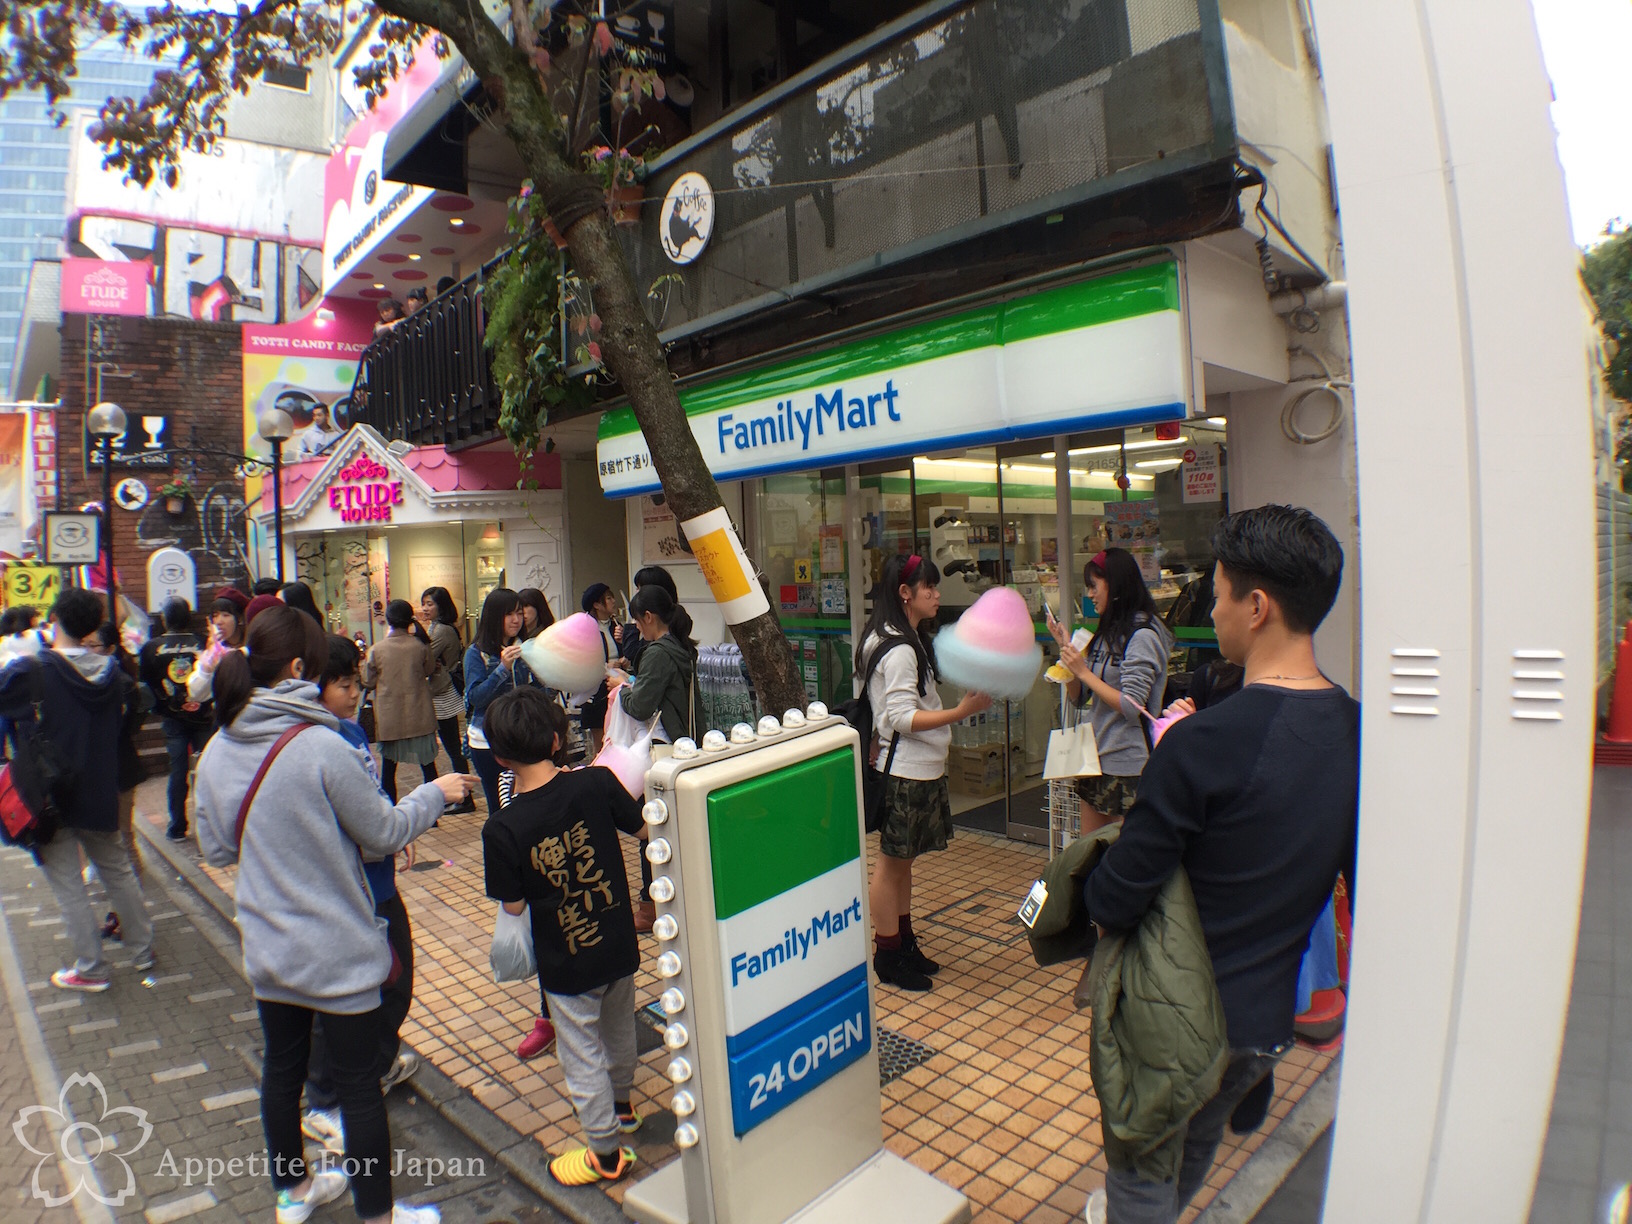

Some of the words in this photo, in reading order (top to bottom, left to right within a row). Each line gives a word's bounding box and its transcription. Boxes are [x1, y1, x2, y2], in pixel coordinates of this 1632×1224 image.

[683, 186, 707, 212] Coffee
[81, 284, 128, 300] ETUDE
[87, 300, 121, 308] HOUSE
[250, 335, 289, 347] TOTTI
[291, 339, 335, 351] CANDY
[717, 379, 901, 454] FamilyMart
[599, 452, 654, 477] 原宿竹下通り
[328, 482, 404, 509] ETUDE
[340, 506, 392, 522] HOUSE
[15, 573, 31, 594] 3
[530, 836, 603, 955] 俺の人生だ
[731, 896, 862, 987] FamilyMart
[748, 1060, 785, 1111] 24
[787, 1012, 863, 1082] OPEN
